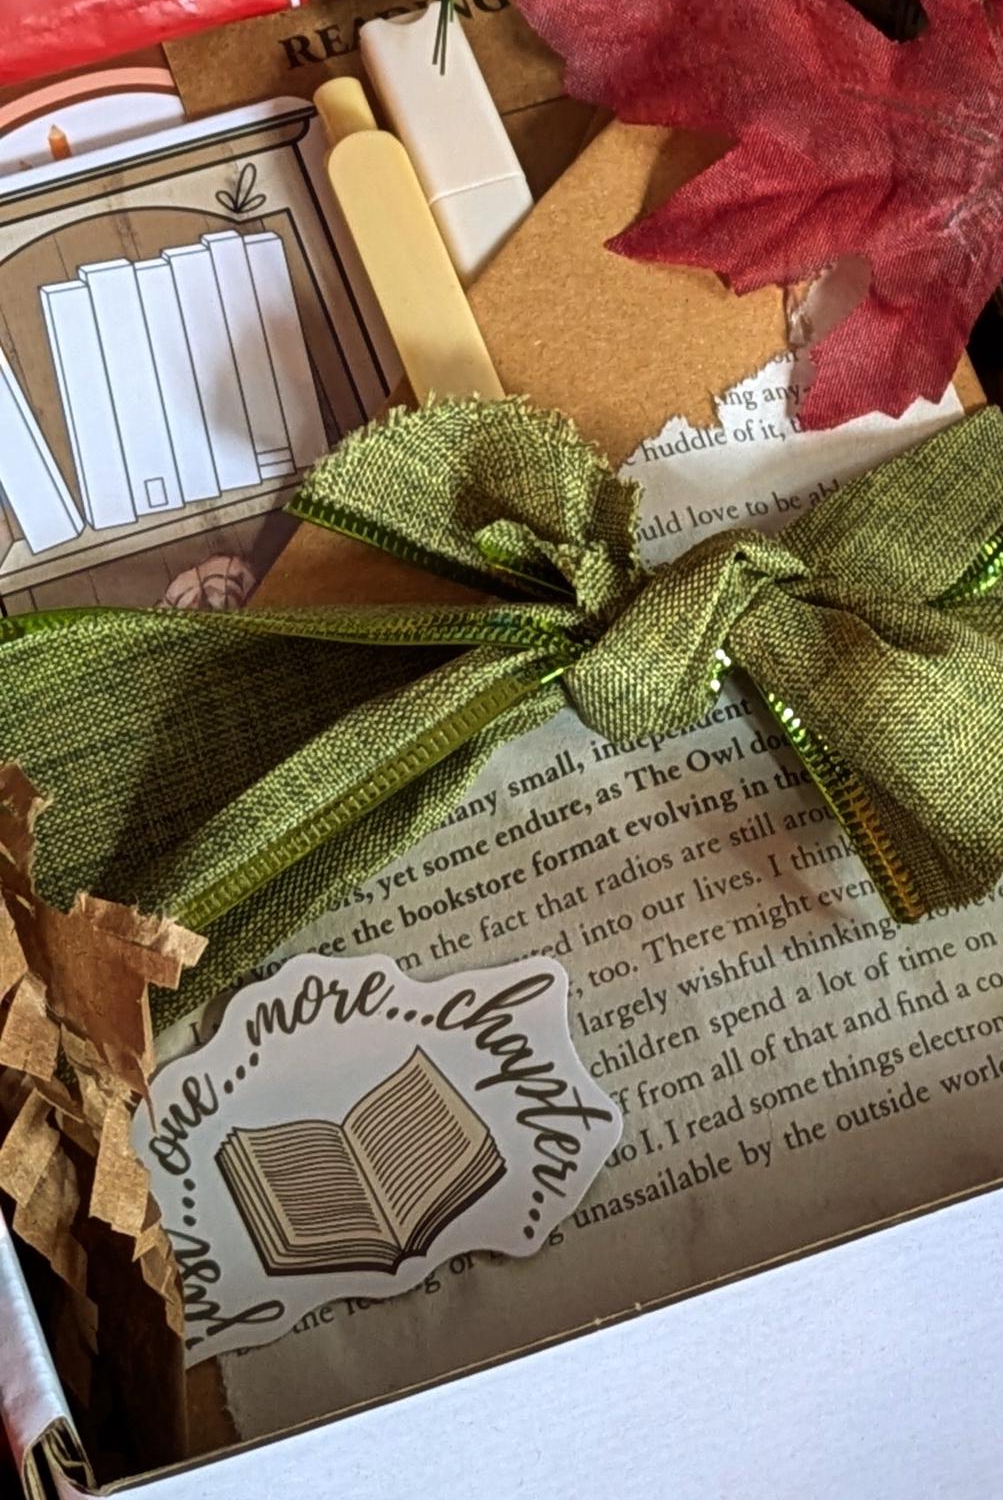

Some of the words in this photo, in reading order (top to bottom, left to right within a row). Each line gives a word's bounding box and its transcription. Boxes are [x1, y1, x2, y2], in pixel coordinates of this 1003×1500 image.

[733, 418, 756, 442] of
[759, 419, 787, 442] it,
[687, 505, 739, 528] love
[745, 501, 769, 517] to
[772, 491, 802, 513] be
[377, 865, 418, 900] yet
[422, 838, 490, 878] some
[495, 798, 592, 848] endure,
[595, 783, 622, 804] as
[624, 764, 682, 793] The
[686, 736, 745, 772] Owl
[507, 750, 585, 798] small,
[352, 918, 395, 945] the
[398, 868, 527, 928] bookstore
[532, 826, 620, 878] format
[626, 787, 738, 837] evolving
[741, 778, 769, 800] in
[430, 933, 473, 960] the
[479, 909, 528, 942] fact
[535, 884, 588, 920] that
[595, 853, 673, 896] radios
[681, 835, 722, 863] are
[729, 810, 776, 847] still
[578, 913, 633, 947] into
[641, 890, 686, 922] our
[693, 868, 762, 902] lives.
[767, 853, 782, 878] I
[588, 960, 638, 988] too.
[642, 923, 726, 965] There
[732, 893, 813, 936] might
[818, 878, 877, 907] even
[577, 987, 667, 1037] largely
[678, 945, 777, 996] wishful
[590, 1025, 700, 1078] children
[709, 986, 787, 1037] spend
[796, 985, 812, 1004] a
[817, 971, 857, 996] lot
[864, 952, 891, 981] of
[898, 941, 957, 972] time
[964, 930, 998, 952] on
[637, 1070, 702, 1109] from
[711, 1051, 745, 1082] all
[750, 1034, 777, 1066] of
[783, 1019, 839, 1055] that
[843, 997, 891, 1033] and
[897, 980, 950, 1017] find
[955, 982, 971, 1000] a
[573, 1153, 733, 1229] unassailable
[738, 1138, 772, 1168] by
[784, 1119, 826, 1150] the
[835, 1081, 931, 1131] outside
[640, 1128, 663, 1156] I.
[665, 1119, 681, 1145] I
[686, 1095, 745, 1139] read
[750, 1075, 818, 1114] some
[822, 1046, 905, 1089] things
